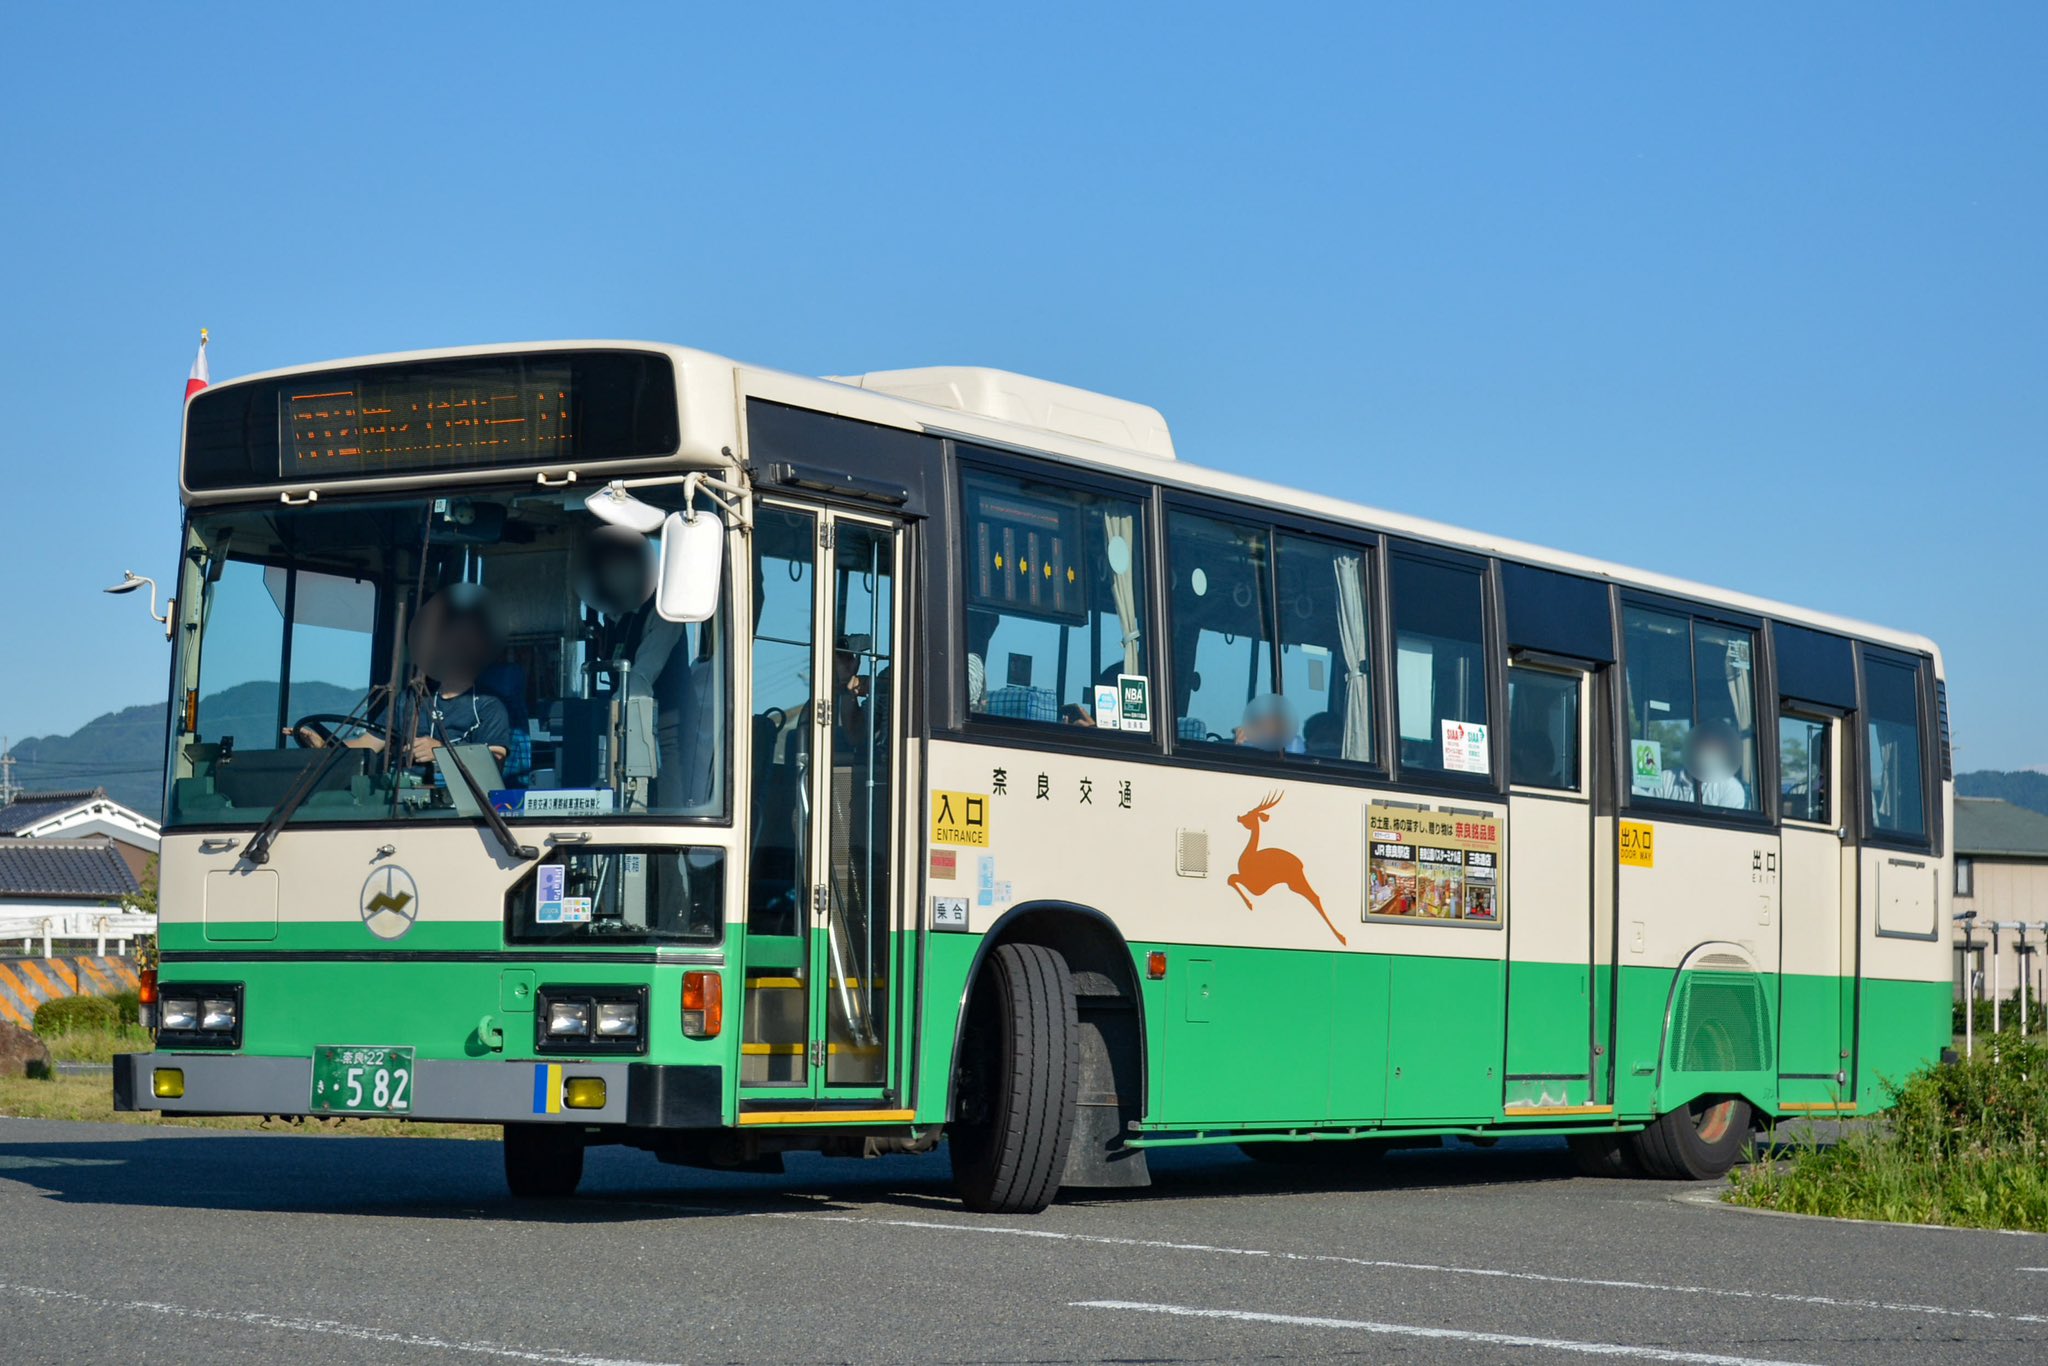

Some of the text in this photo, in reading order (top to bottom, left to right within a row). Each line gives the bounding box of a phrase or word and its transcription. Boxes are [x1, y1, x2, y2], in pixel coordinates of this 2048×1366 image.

[1125, 687, 1143, 701] NBA
[992, 766, 1132, 809] 奈良交通
[937, 794, 983, 827] 入口
[936, 828, 983, 844] ENTRANCE
[1621, 827, 1651, 849] 出入口
[1620, 849, 1652, 862] DOOR WAY
[1752, 849, 1776, 873] 出口
[936, 902, 964, 921] 乗合
